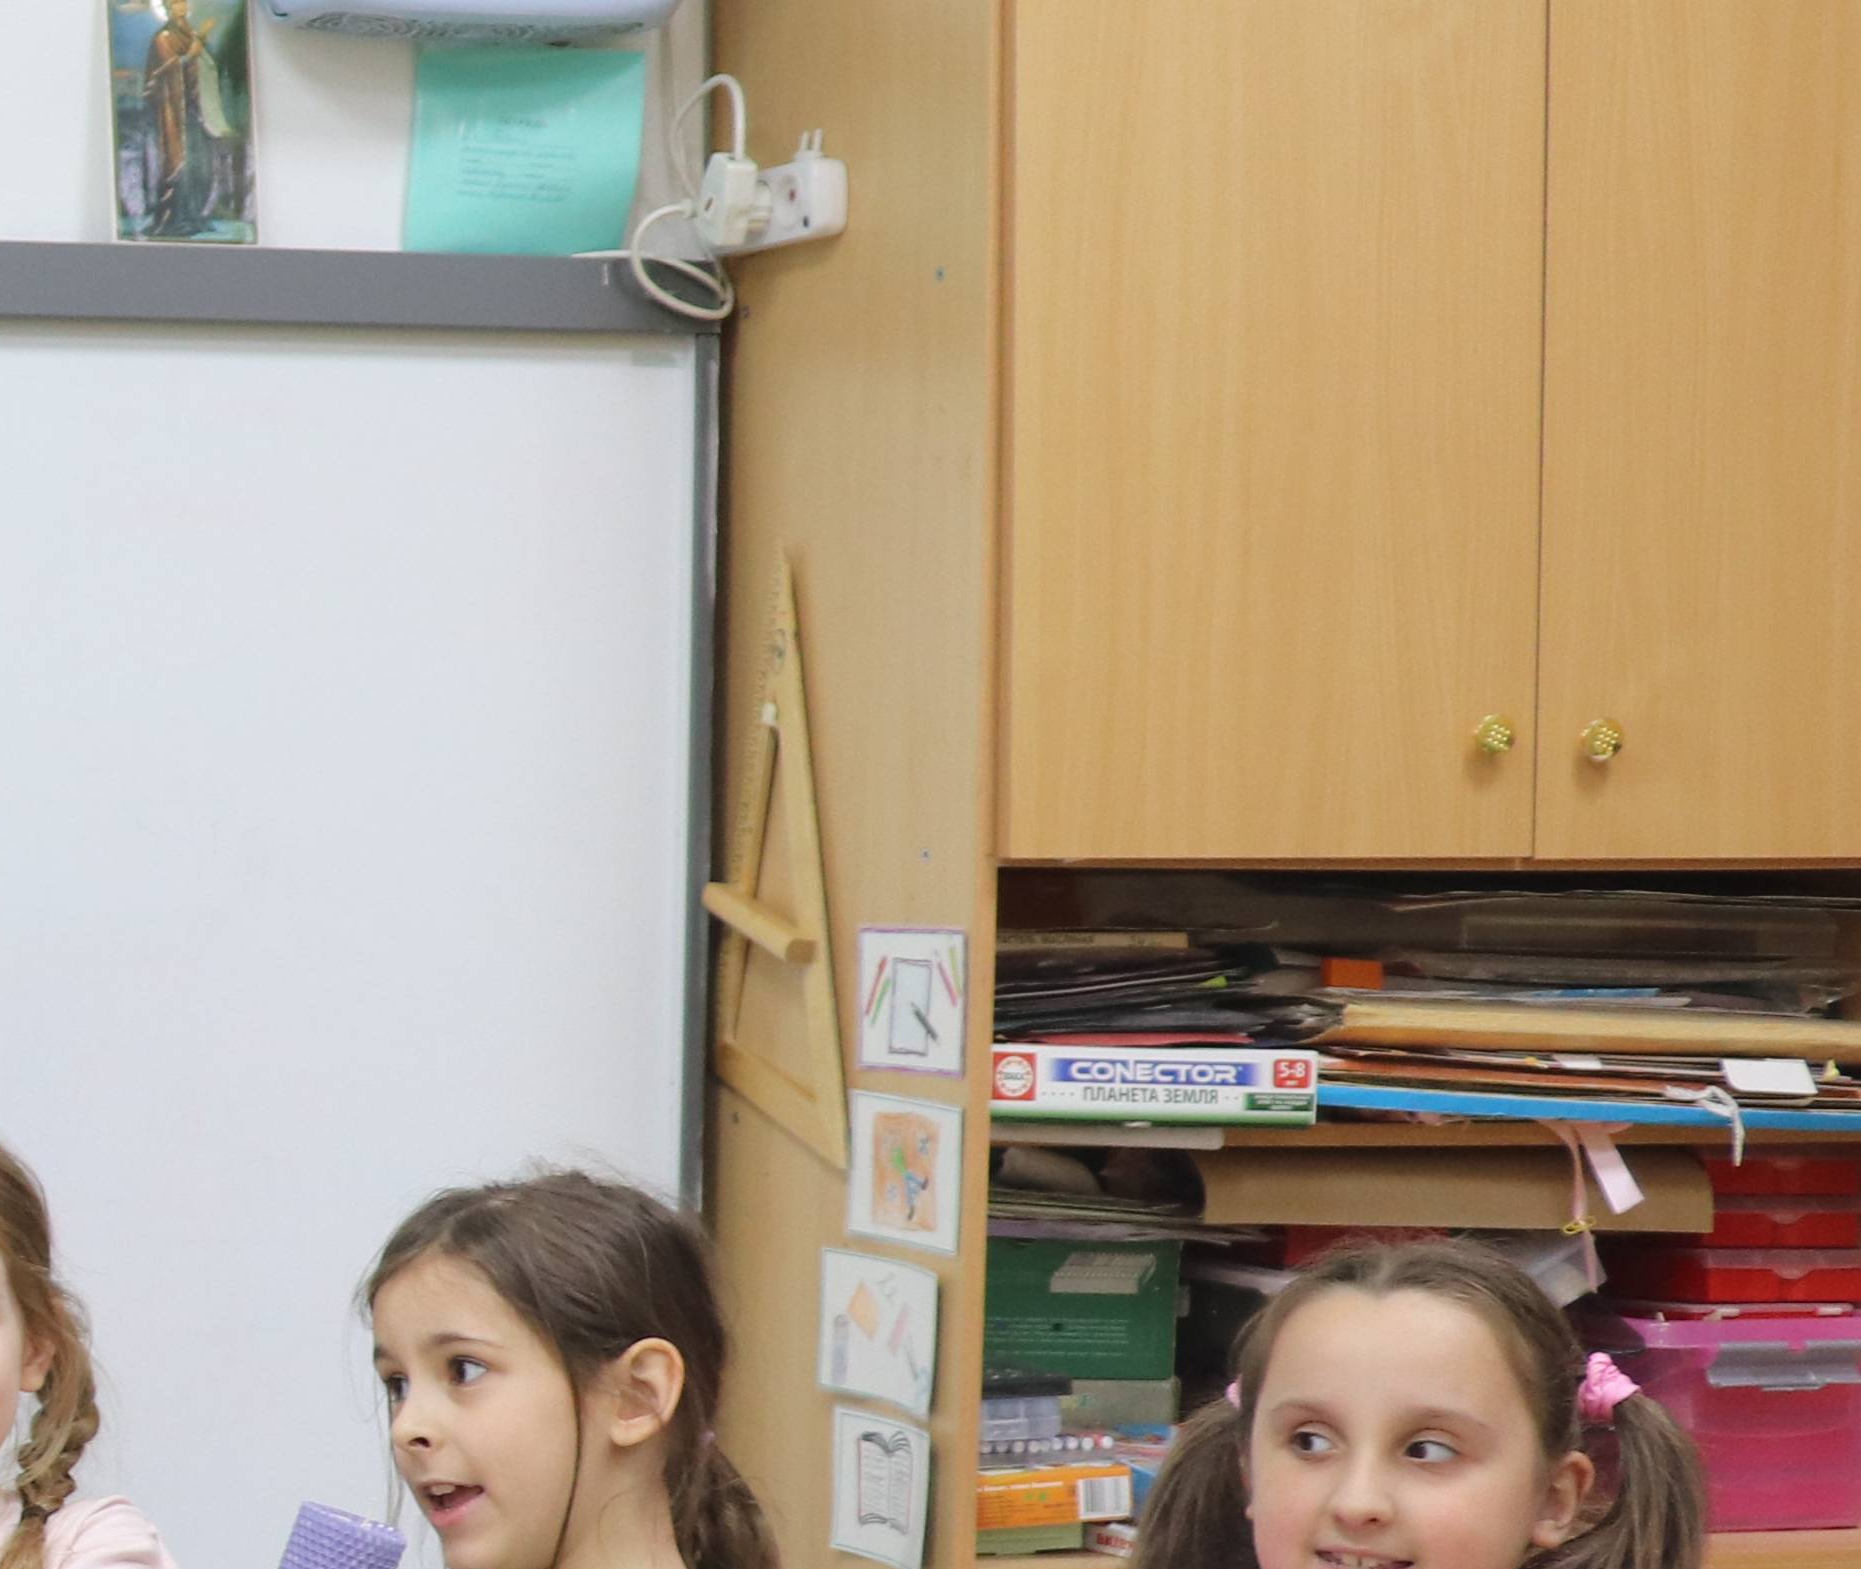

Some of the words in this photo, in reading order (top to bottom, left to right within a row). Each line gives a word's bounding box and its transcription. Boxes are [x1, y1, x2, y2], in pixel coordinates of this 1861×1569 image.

[1070, 1060, 1237, 1084] CONECTOR
[1082, 1086, 1160, 1104] ПЛАНЕТА
[1163, 1088, 1219, 1105] ЗЕМЛЯ
